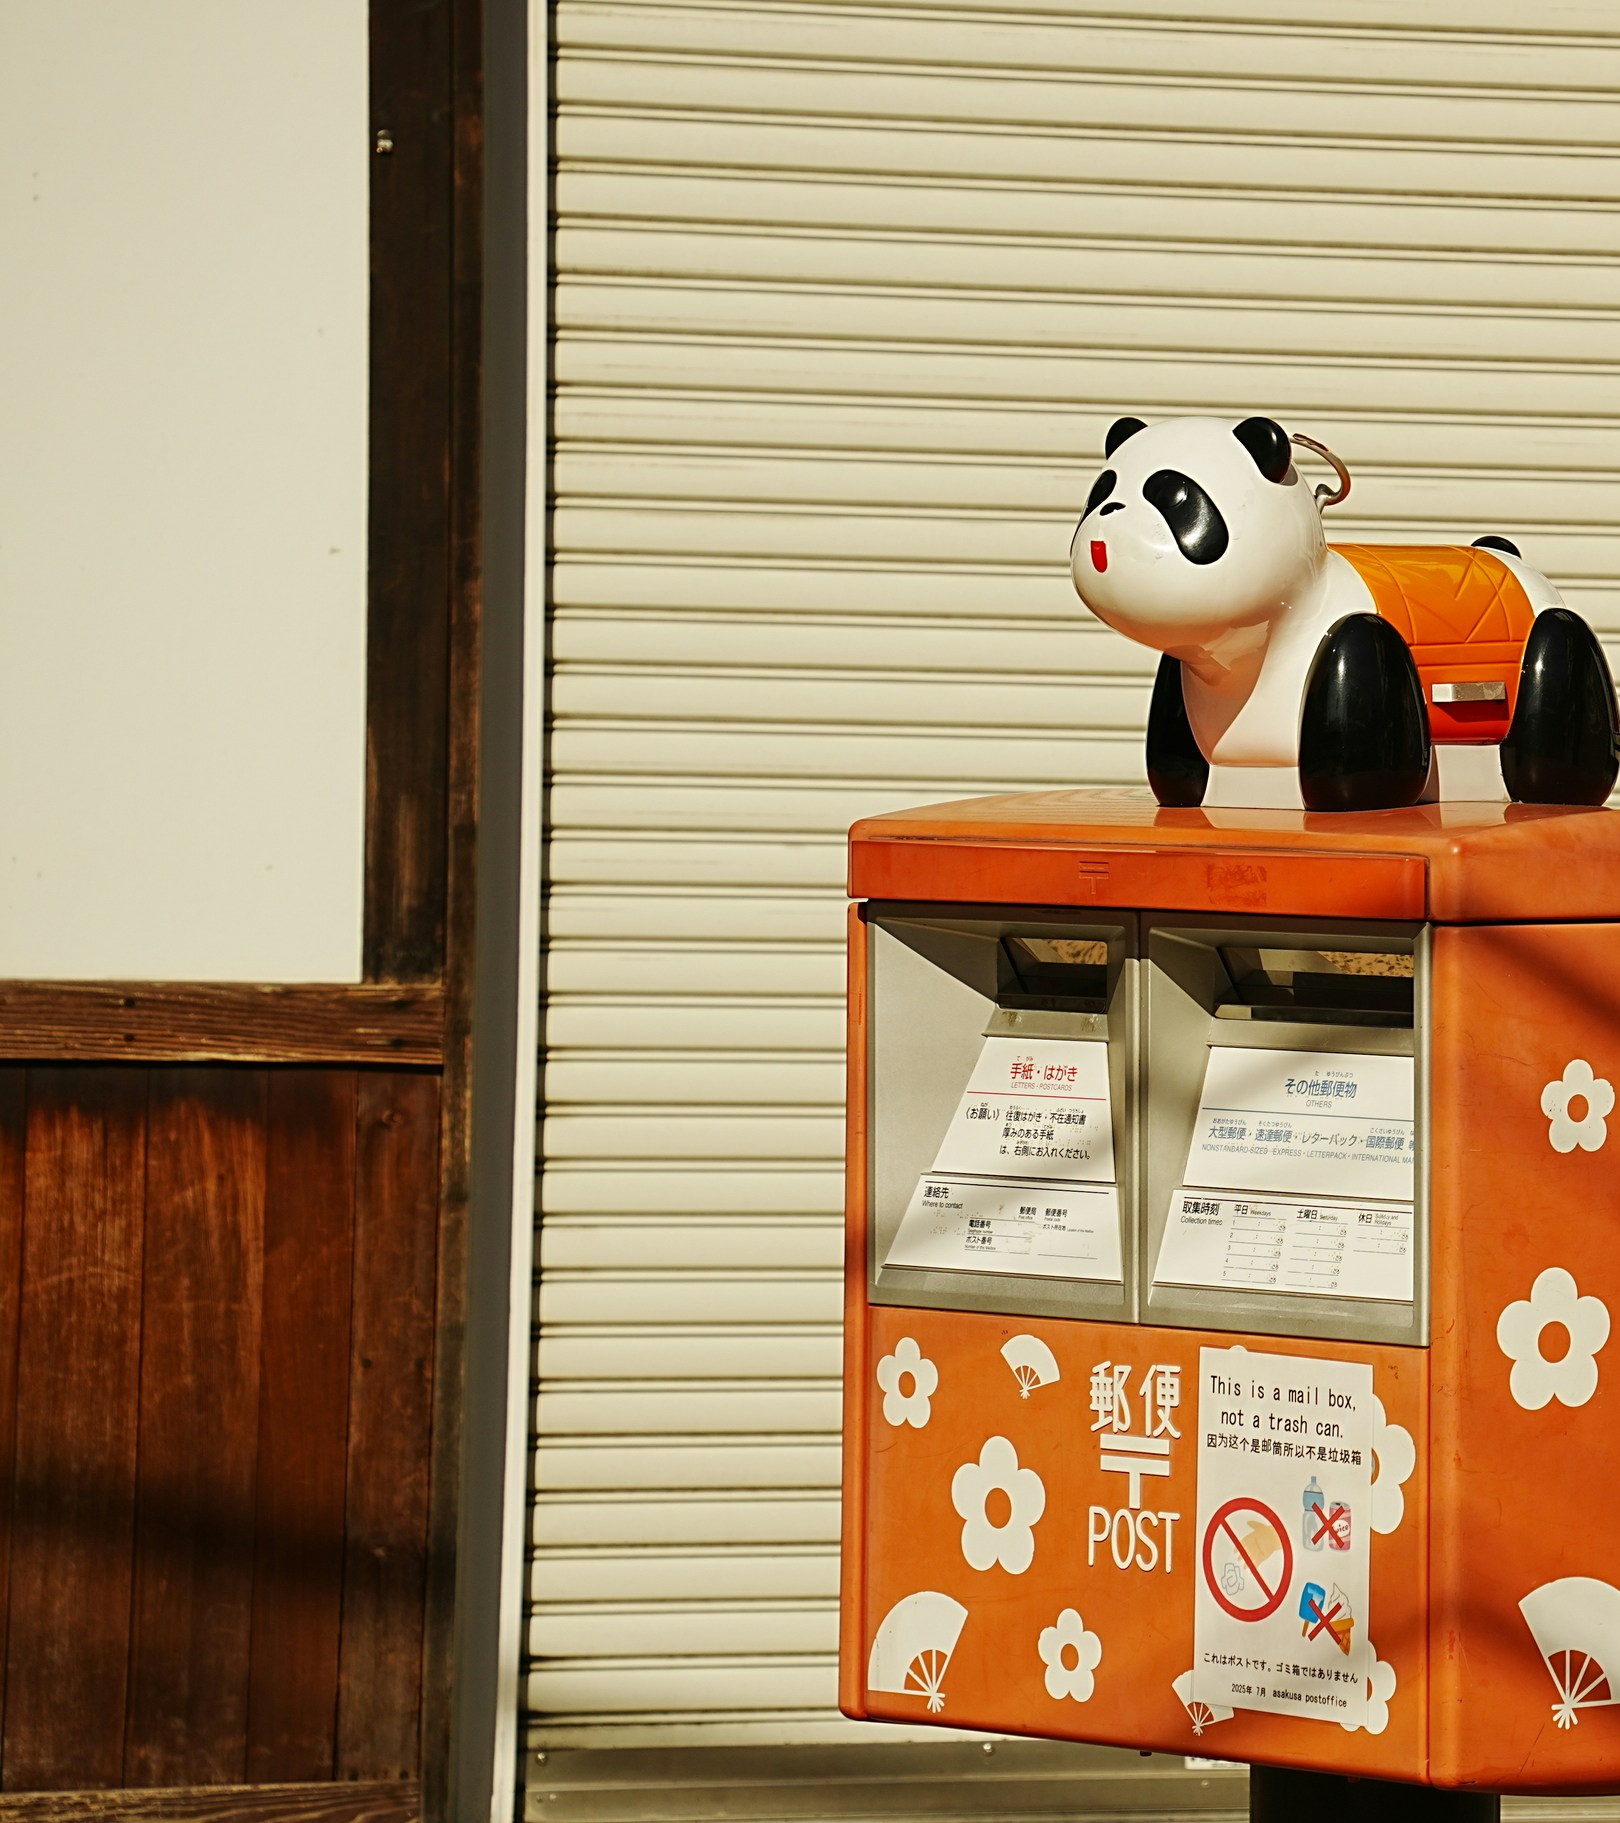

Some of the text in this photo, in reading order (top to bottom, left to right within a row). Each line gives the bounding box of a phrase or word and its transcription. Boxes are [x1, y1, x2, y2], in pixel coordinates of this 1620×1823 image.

[1010, 1063, 1078, 1082] 手紙・はがき
[1285, 1078, 1357, 1098] その他郵便物
[1306, 1100, 1332, 1108] OTHERS
[924, 1185, 949, 1199] 連絡先
[922, 1200, 938, 1208] Where
[1182, 1200, 1221, 1216] 取集時刻
[1234, 1204, 1248, 1215] 平日
[1180, 1215, 1207, 1225] Collection
[1296, 1209, 1318, 1220] 土曜日
[1358, 1213, 1373, 1224] 休日
[1090, 1361, 1181, 1438] 郵便
[1211, 1375, 1356, 1412] This is a mail box,
[1221, 1409, 1343, 1439] not a trash can.
[1088, 1506, 1180, 1573] POST
[1231, 1683, 1347, 1708] 2025年 7月 asakusa postoffice
